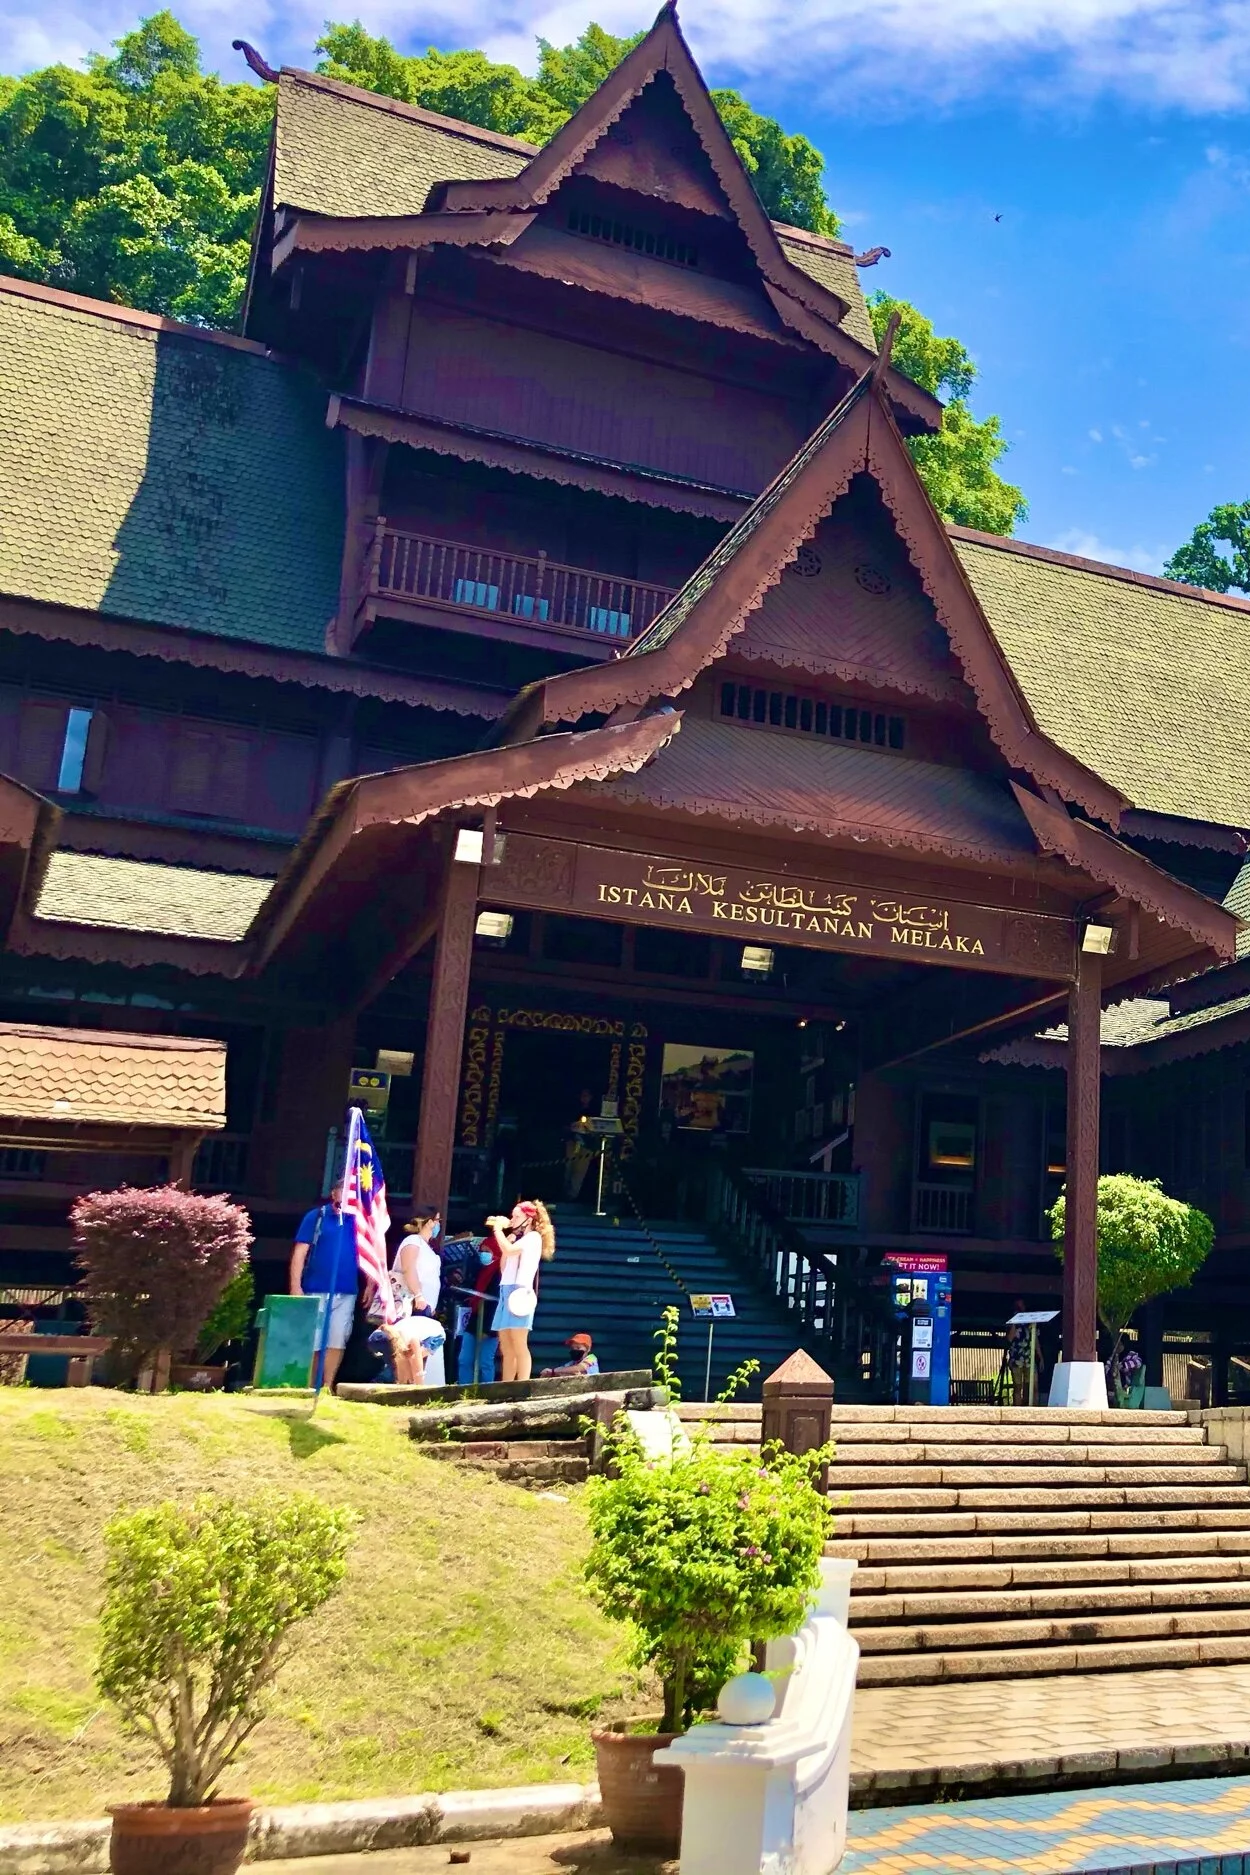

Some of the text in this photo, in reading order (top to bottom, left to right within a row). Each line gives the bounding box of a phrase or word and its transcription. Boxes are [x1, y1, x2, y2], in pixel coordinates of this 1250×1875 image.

[597, 884, 985, 955] ISTANA KESULTANAN MELAKA
[918, 1263, 940, 1271] NOW!
